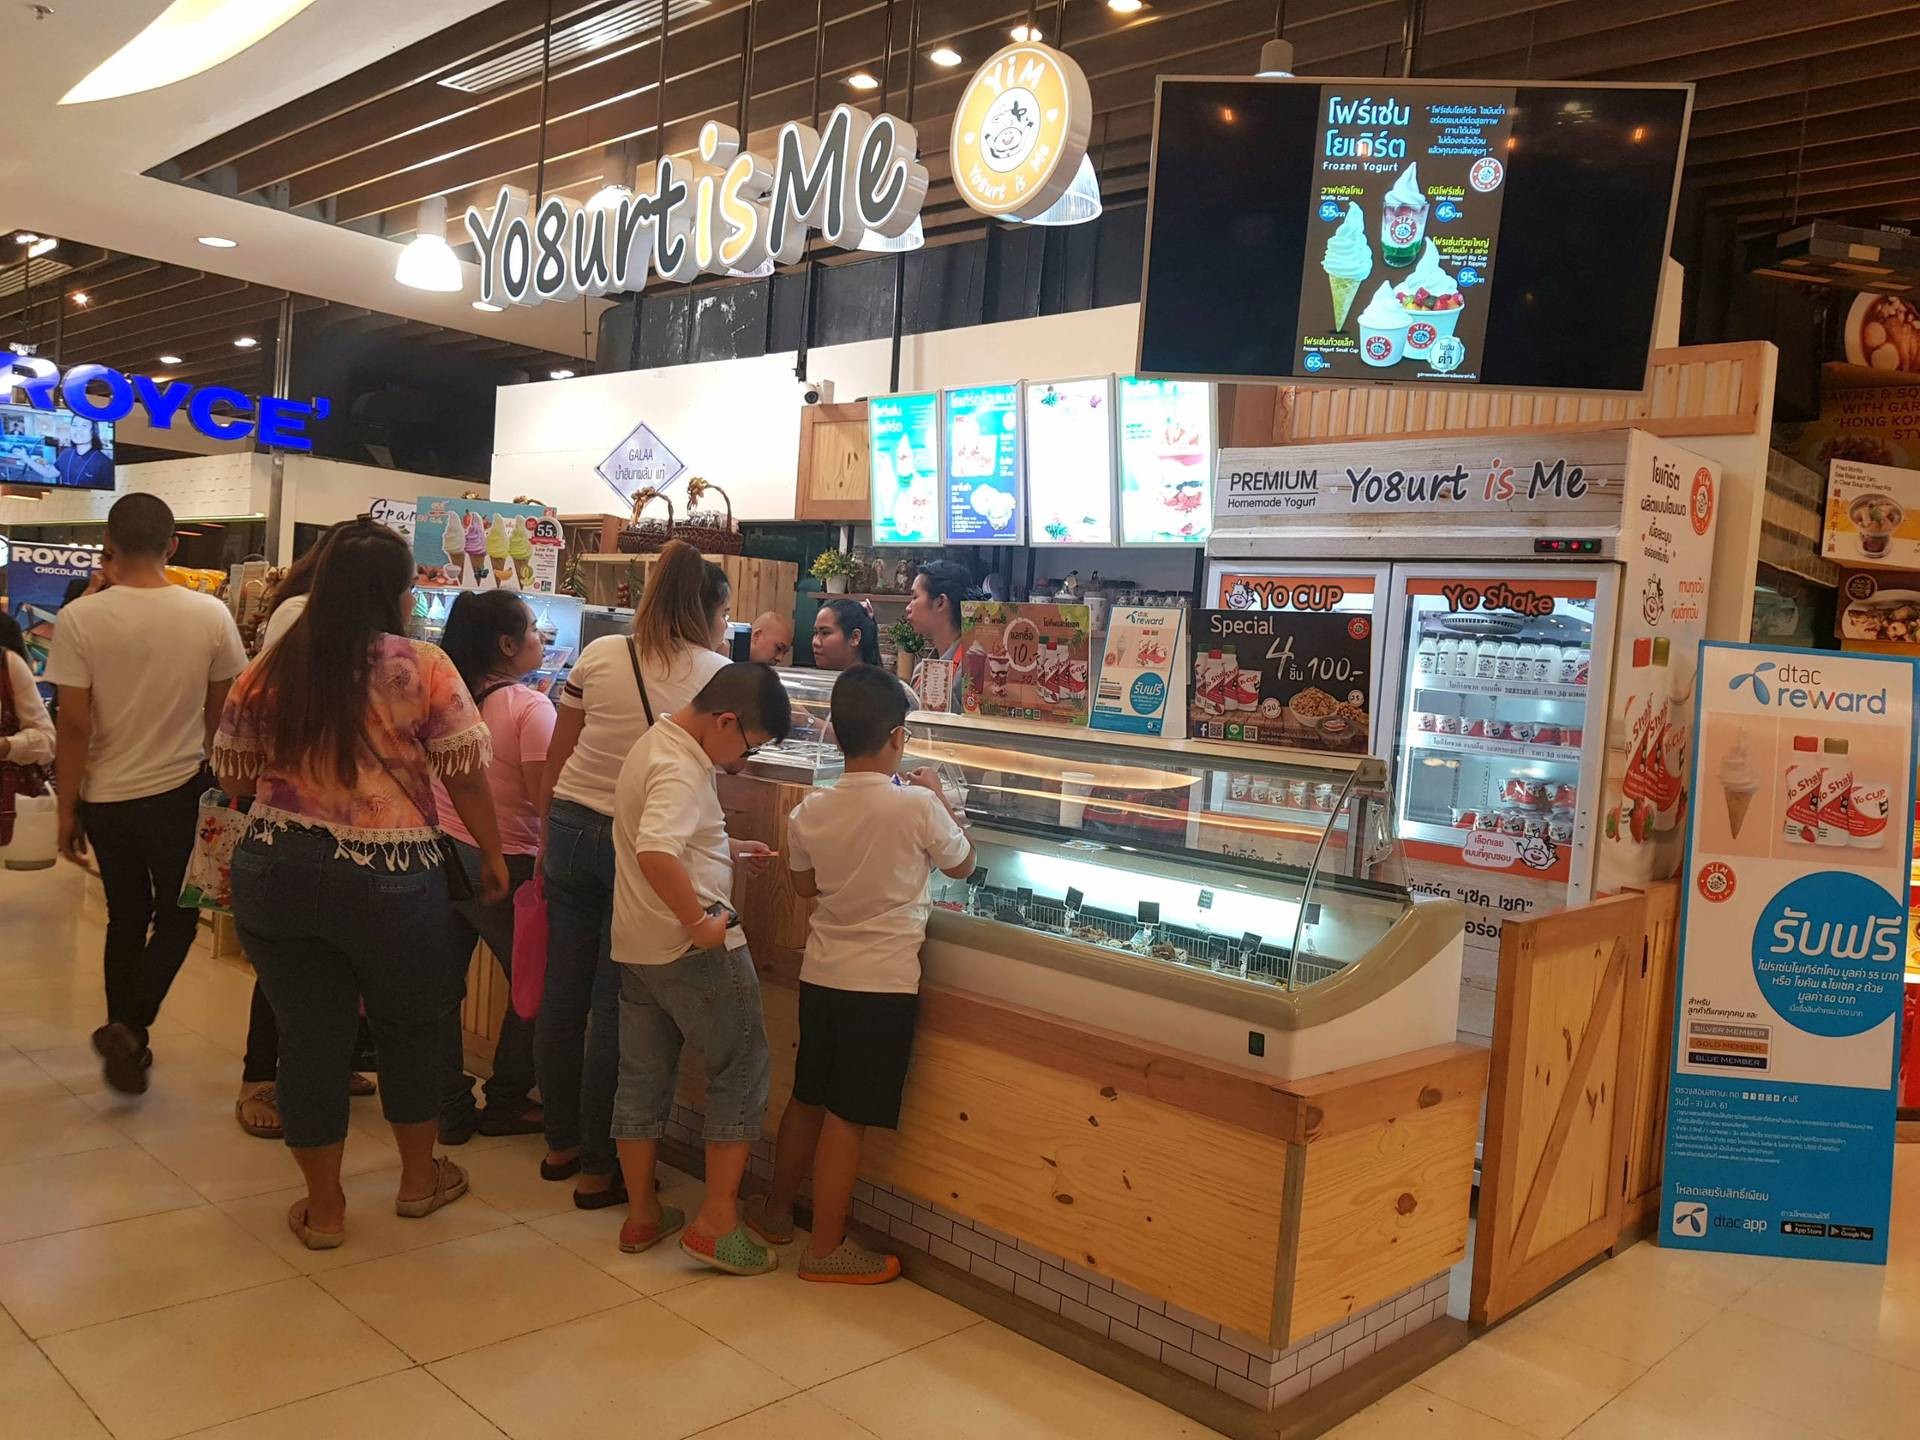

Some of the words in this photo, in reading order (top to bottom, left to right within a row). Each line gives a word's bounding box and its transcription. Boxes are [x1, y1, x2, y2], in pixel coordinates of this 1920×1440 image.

[1325, 130, 1406, 158] โยเกิร์ต
[1323, 162, 1358, 172] Frozen
[1363, 162, 1399, 174] Yogurt
[694, 125, 759, 270] is
[769, 110, 908, 258] Me
[1322, 205, 1336, 217] 55
[1437, 206, 1454, 219] 45
[1460, 271, 1476, 284] 95
[1306, 355, 1322, 368] 65
[1842, 402, 1883, 415] WITH
[628, 448, 654, 462] GALAA
[1229, 470, 1317, 491] PREMIUM
[1483, 457, 1515, 501] is
[1527, 458, 1588, 501] Me
[1227, 496, 1281, 509] Homemade
[1283, 495, 1317, 510] Yogurt
[34, 566, 88, 578] CHOCOLATE
[1291, 584, 1344, 611] CUP
[1483, 582, 1555, 617] Shake
[1136, 616, 1165, 626] reward
[1210, 615, 1274, 639] Special
[1265, 635, 1296, 681] 4
[1778, 664, 1822, 686] dtac
[1134, 681, 1164, 698] รับฟรี
[1777, 687, 1887, 715] reward
[1464, 916, 1501, 938] อร่อ
[1769, 906, 1903, 962] รับฟรี
[1841, 968, 1867, 982] มูลค่า
[1868, 971, 1880, 979] 55
[1881, 972, 1900, 982] บาท
[1771, 976, 1791, 987] หรือ
[1856, 984, 1862, 992] 2
[1797, 991, 1823, 1004] มูลค่า
[1824, 993, 1836, 1002] 60
[1837, 994, 1856, 1005] บาท
[1693, 1025, 1724, 1035] SILVER
[1725, 1028, 1766, 1038] MEMBER
[1696, 1040, 1721, 1049] GOLD
[1721, 1042, 1762, 1052] MEMBER
[1695, 1055, 1719, 1063] BLUE
[1720, 1056, 1760, 1067] MEMBER
[1719, 1102, 1728, 1110] 61
[1713, 1214, 1742, 1230] dtac
[1743, 1217, 1768, 1234] app
